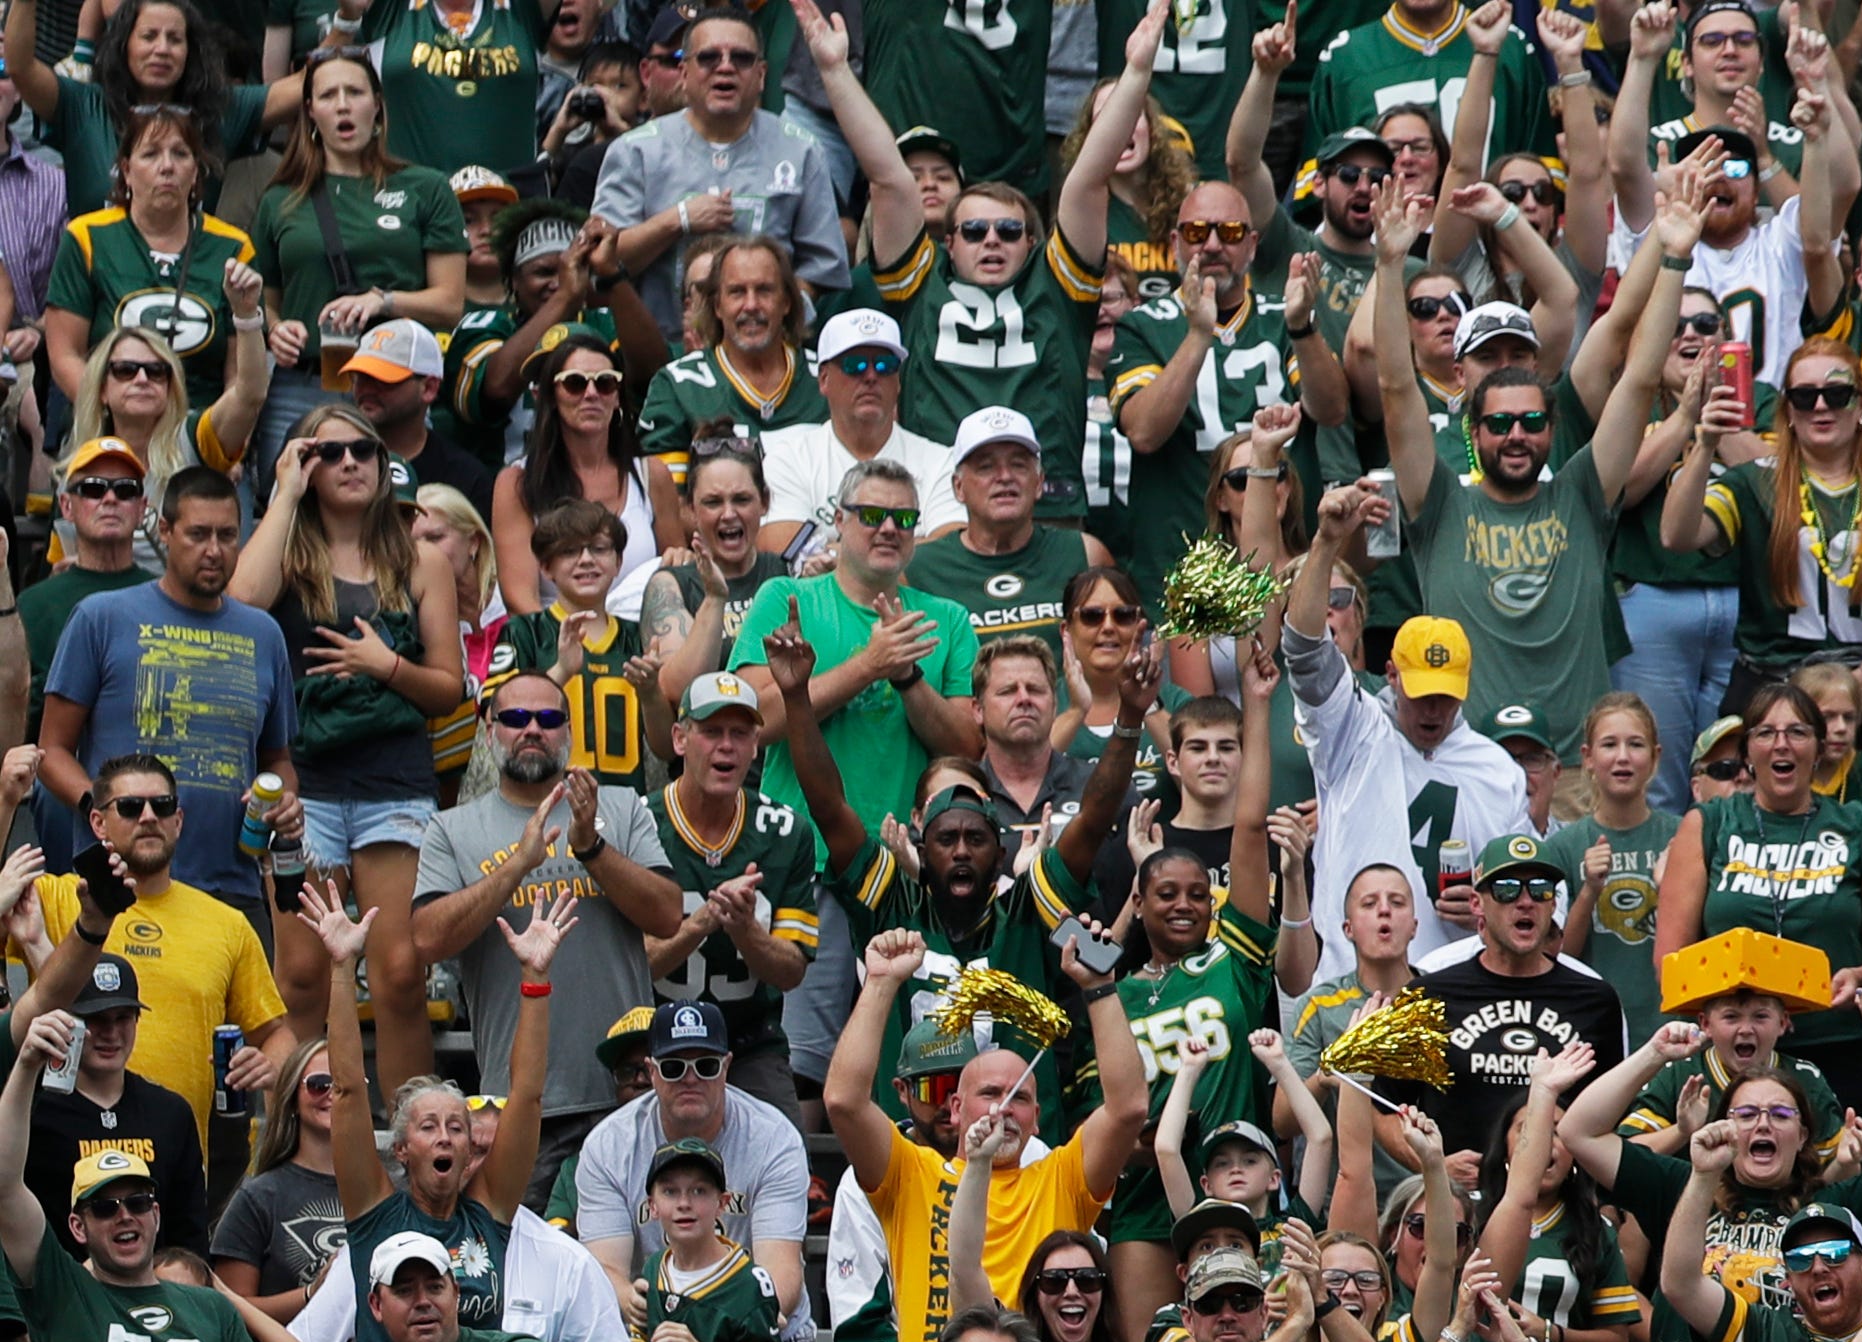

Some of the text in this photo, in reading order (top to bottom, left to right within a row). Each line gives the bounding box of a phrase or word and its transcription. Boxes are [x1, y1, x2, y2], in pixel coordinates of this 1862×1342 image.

[935, 282, 1037, 368] 21
[985, 575, 1024, 598] G
[563, 675, 640, 774] 10
[1496, 705, 1534, 725] G
[1406, 779, 1459, 903] 4
[512, 875, 599, 908] OOTBAL
[1610, 885, 1644, 909] G
[126, 920, 163, 943] G
[1450, 999, 1533, 1051] GREEN
[1503, 1026, 1536, 1051] G
[1471, 1053, 1534, 1077] PACK
[97, 1152, 131, 1170] G
[131, 1306, 174, 1332] G
